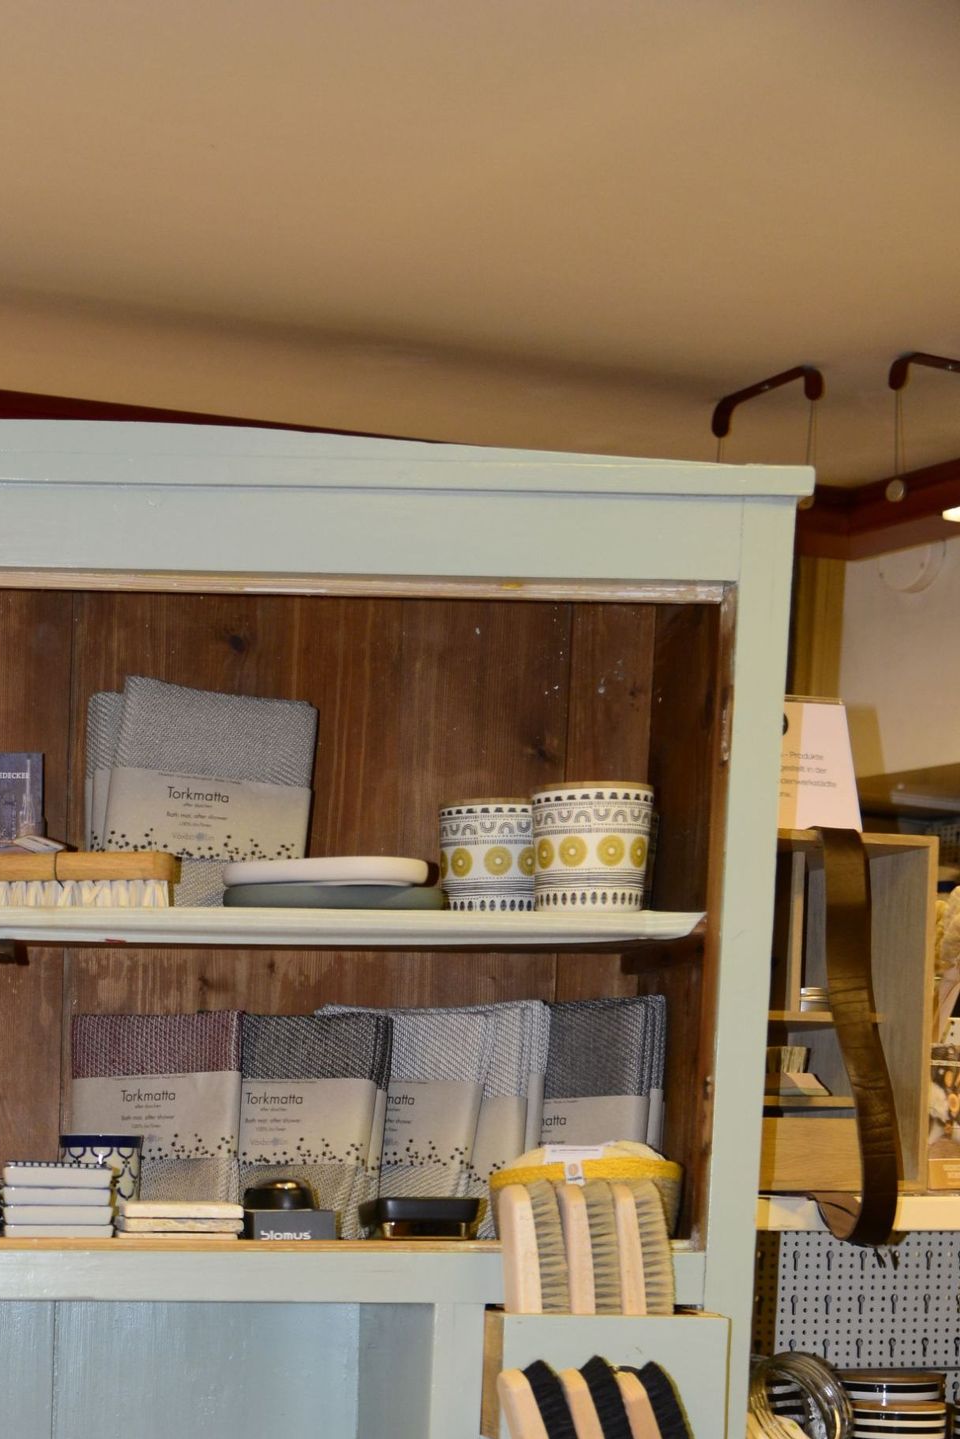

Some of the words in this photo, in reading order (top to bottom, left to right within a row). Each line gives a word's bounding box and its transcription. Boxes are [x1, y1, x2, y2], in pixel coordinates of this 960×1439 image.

[167, 786, 230, 803] Torkmatta
[121, 1089, 176, 1102] Torkmatta
[246, 1092, 303, 1105] Torkmatta
[260, 1230, 311, 1240] blomus
